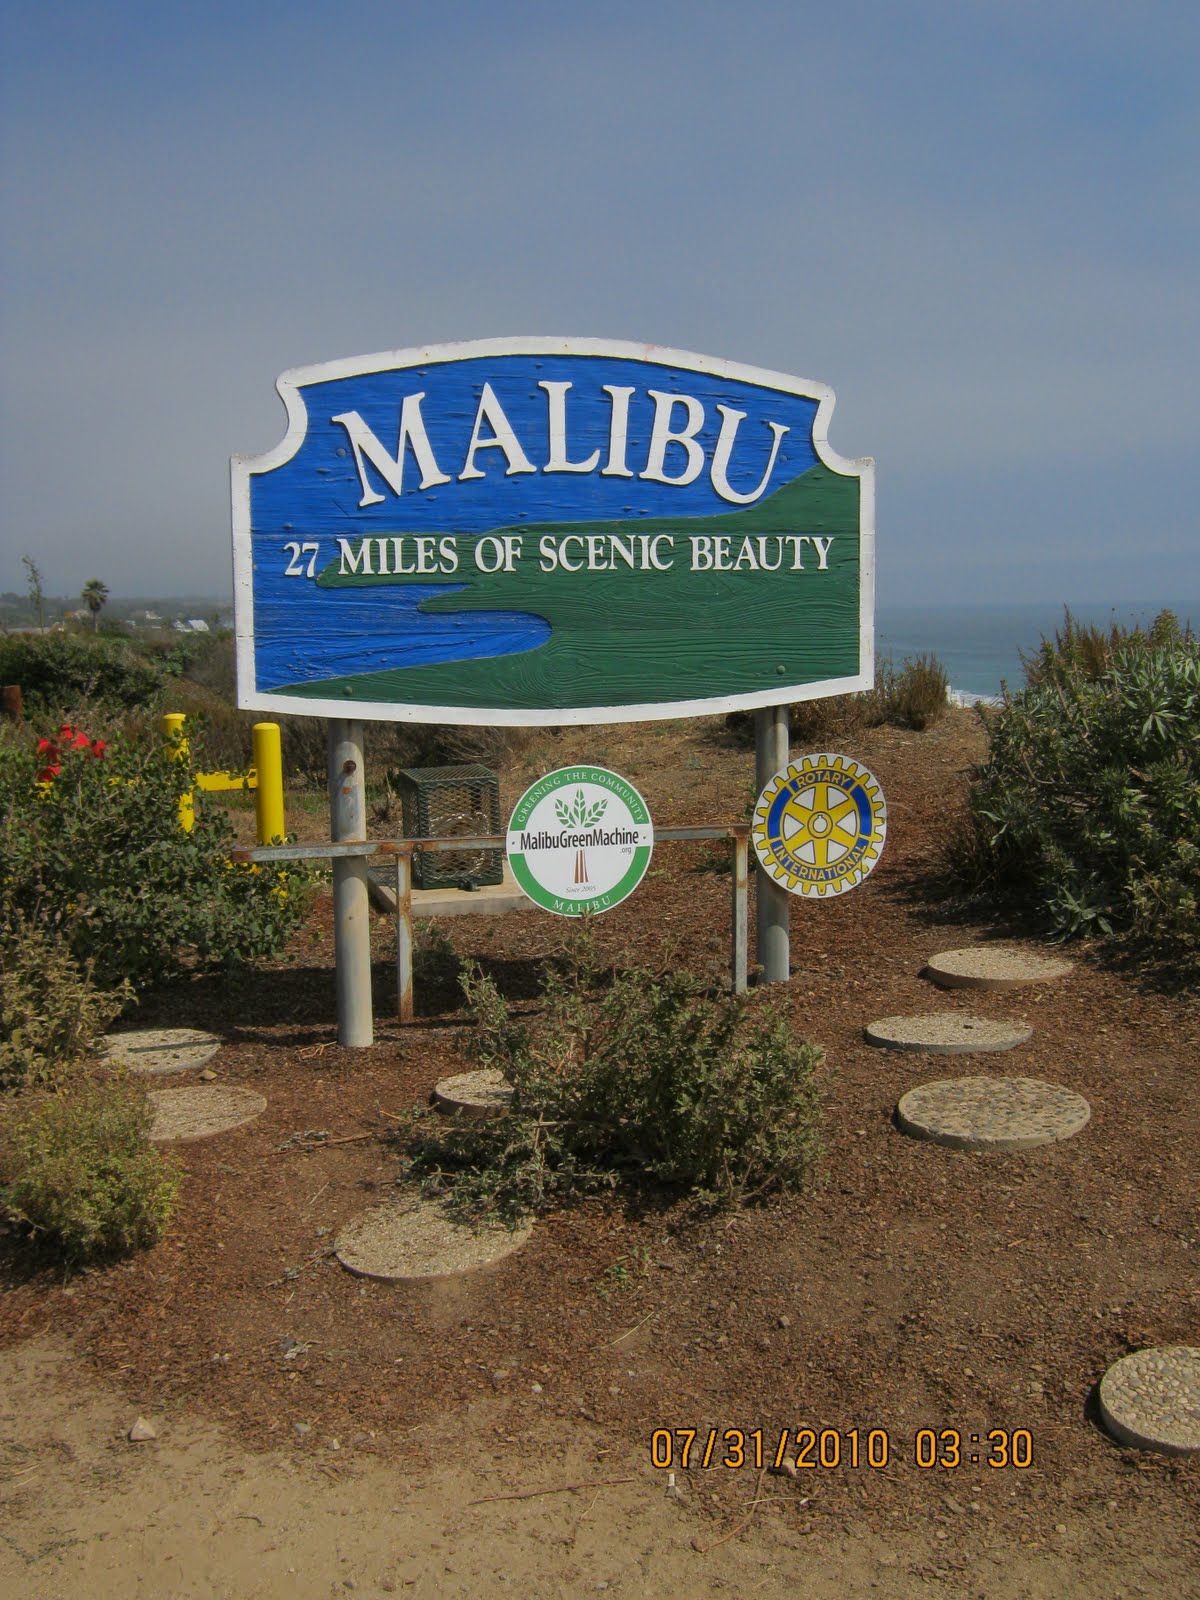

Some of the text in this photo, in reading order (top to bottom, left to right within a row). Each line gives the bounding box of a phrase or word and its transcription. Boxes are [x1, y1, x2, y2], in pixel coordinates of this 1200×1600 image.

[330, 381, 790, 507] MALIBU
[284, 534, 835, 578] 27 MILES OF SCENIC BEAUTY
[796, 770, 851, 788] ROTARY
[517, 772, 644, 823] GREENING THE COMMUNITY
[520, 828, 639, 850] MalibuGreenMachine
[774, 845, 866, 881] INTERNATIONAL
[553, 896, 611, 912] MALIBU
